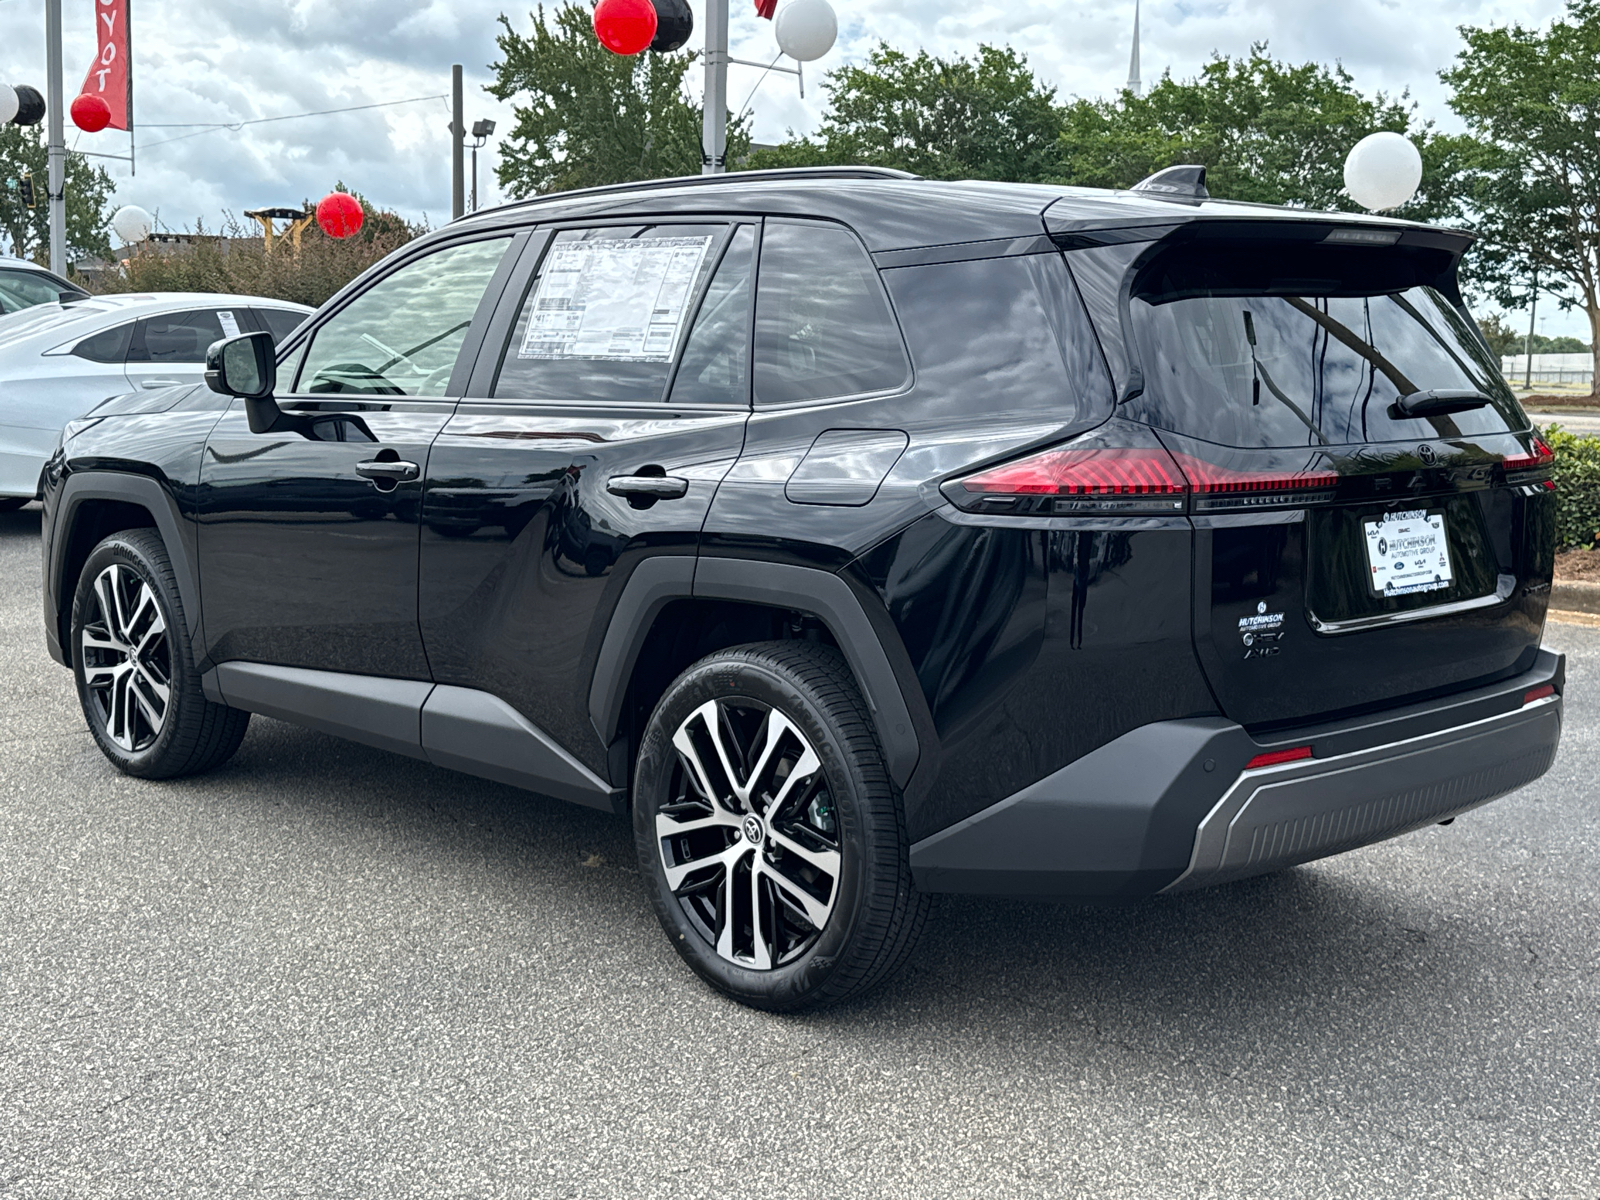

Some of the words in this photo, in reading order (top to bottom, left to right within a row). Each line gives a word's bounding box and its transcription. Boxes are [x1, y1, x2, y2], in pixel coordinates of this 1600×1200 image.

[95, 0, 117, 92] YOT
[1390, 509, 1427, 521] HUTCHINSON
[1389, 534, 1436, 551] HUTCHINSON
[1391, 549, 1419, 559] AUTOMOTIVE
[1420, 546, 1436, 557] GROUP
[1239, 614, 1283, 627] HUTCHINSON
[788, 693, 858, 843] BRIDGESTONE
